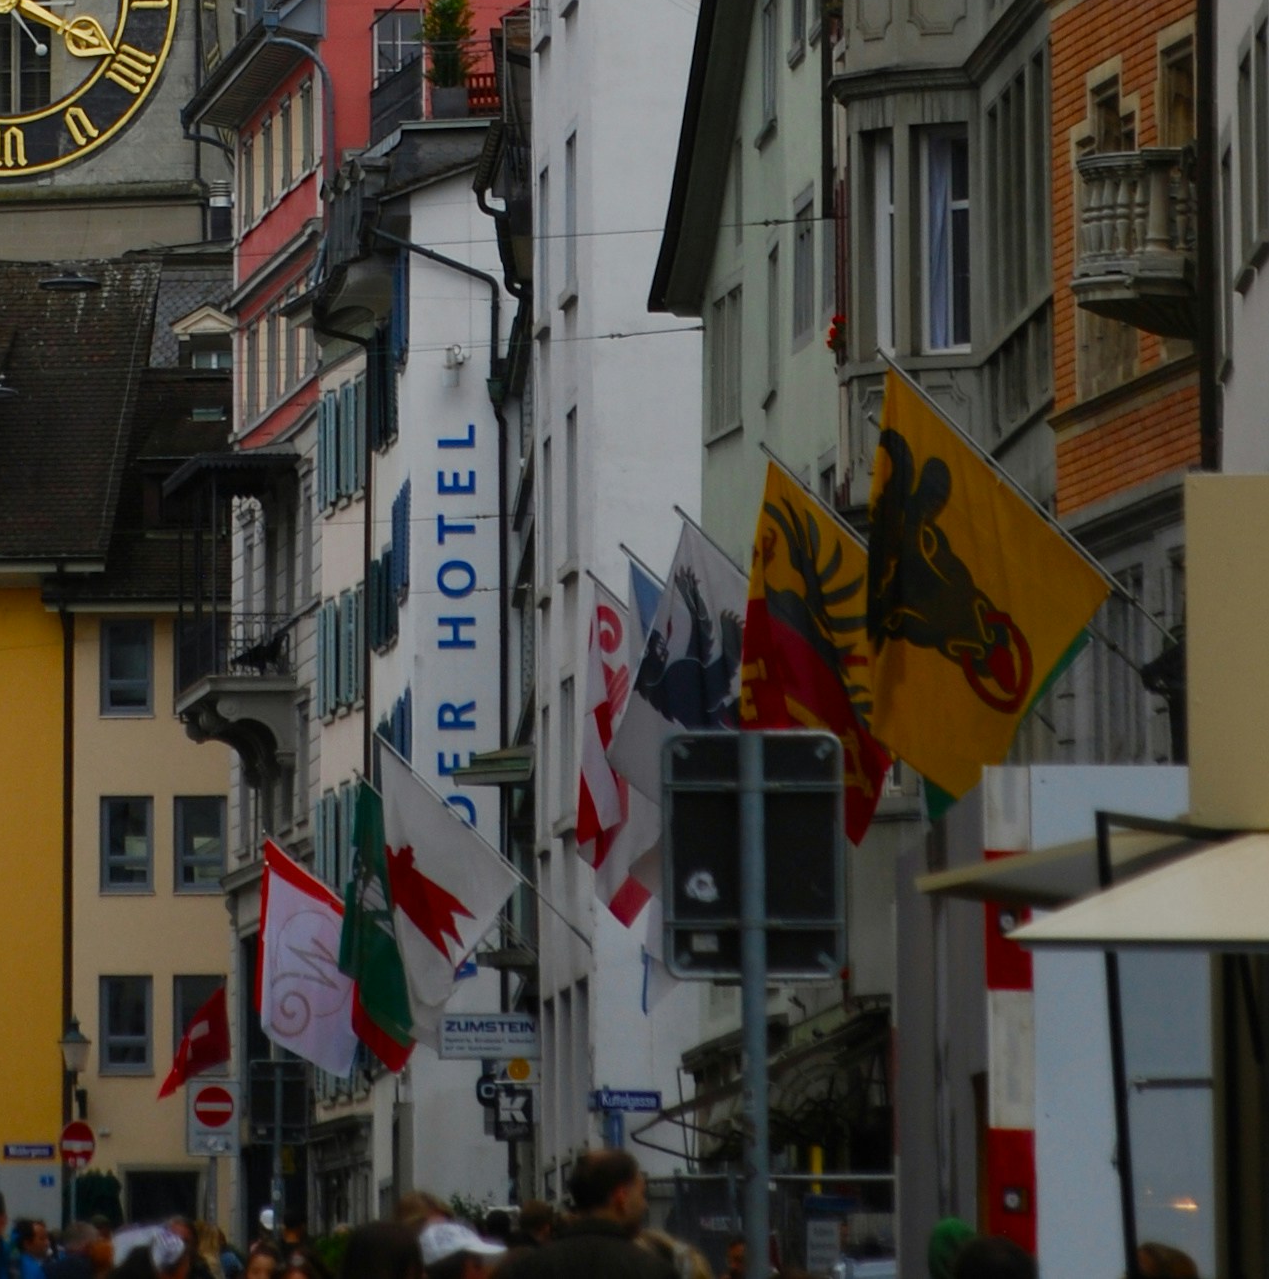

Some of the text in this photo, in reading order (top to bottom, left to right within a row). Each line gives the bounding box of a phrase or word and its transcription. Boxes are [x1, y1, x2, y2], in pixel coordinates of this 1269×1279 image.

[105, 43, 158, 95] IIII
[437, 424, 477, 650] HOTEL
[445, 1020, 536, 1033] ZUMSTEIN
